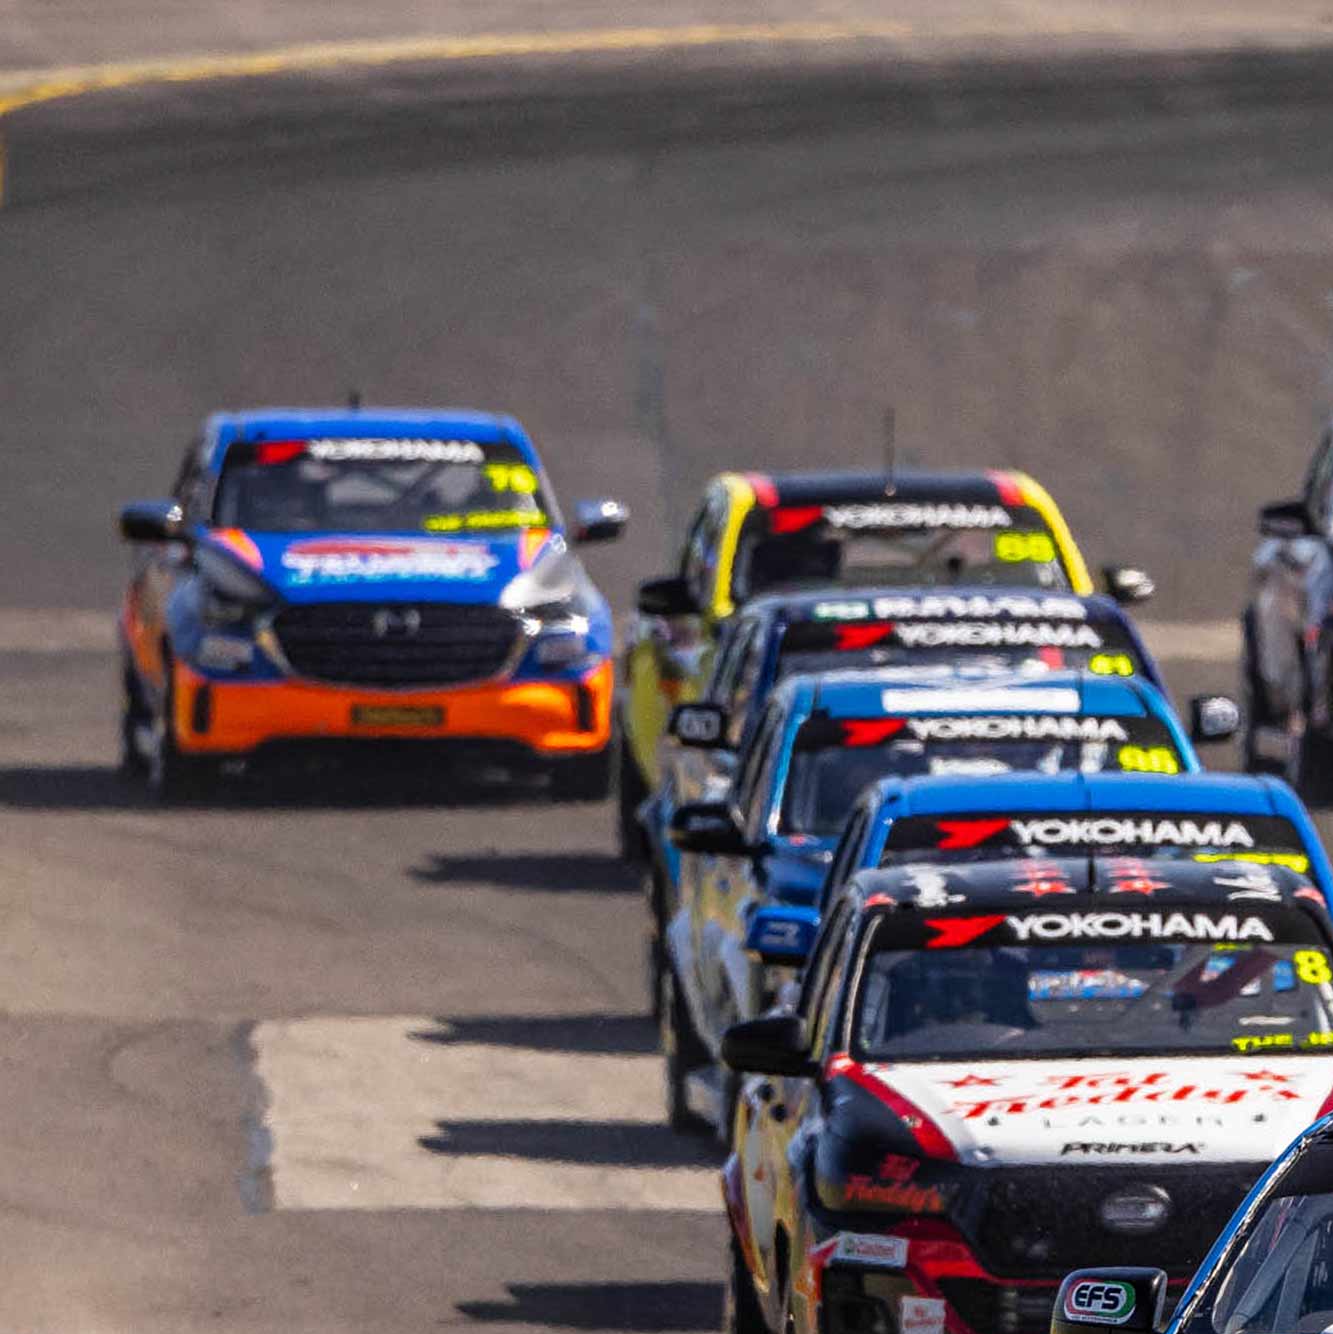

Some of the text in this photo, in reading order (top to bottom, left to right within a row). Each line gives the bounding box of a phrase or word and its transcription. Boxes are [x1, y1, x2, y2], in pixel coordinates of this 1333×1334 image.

[1010, 820, 1253, 846] YOKOHAMA
[1008, 913, 1273, 941] YOKOHAMA
[1294, 950, 1332, 984] 8
[1074, 1284, 1124, 1310] EFS
